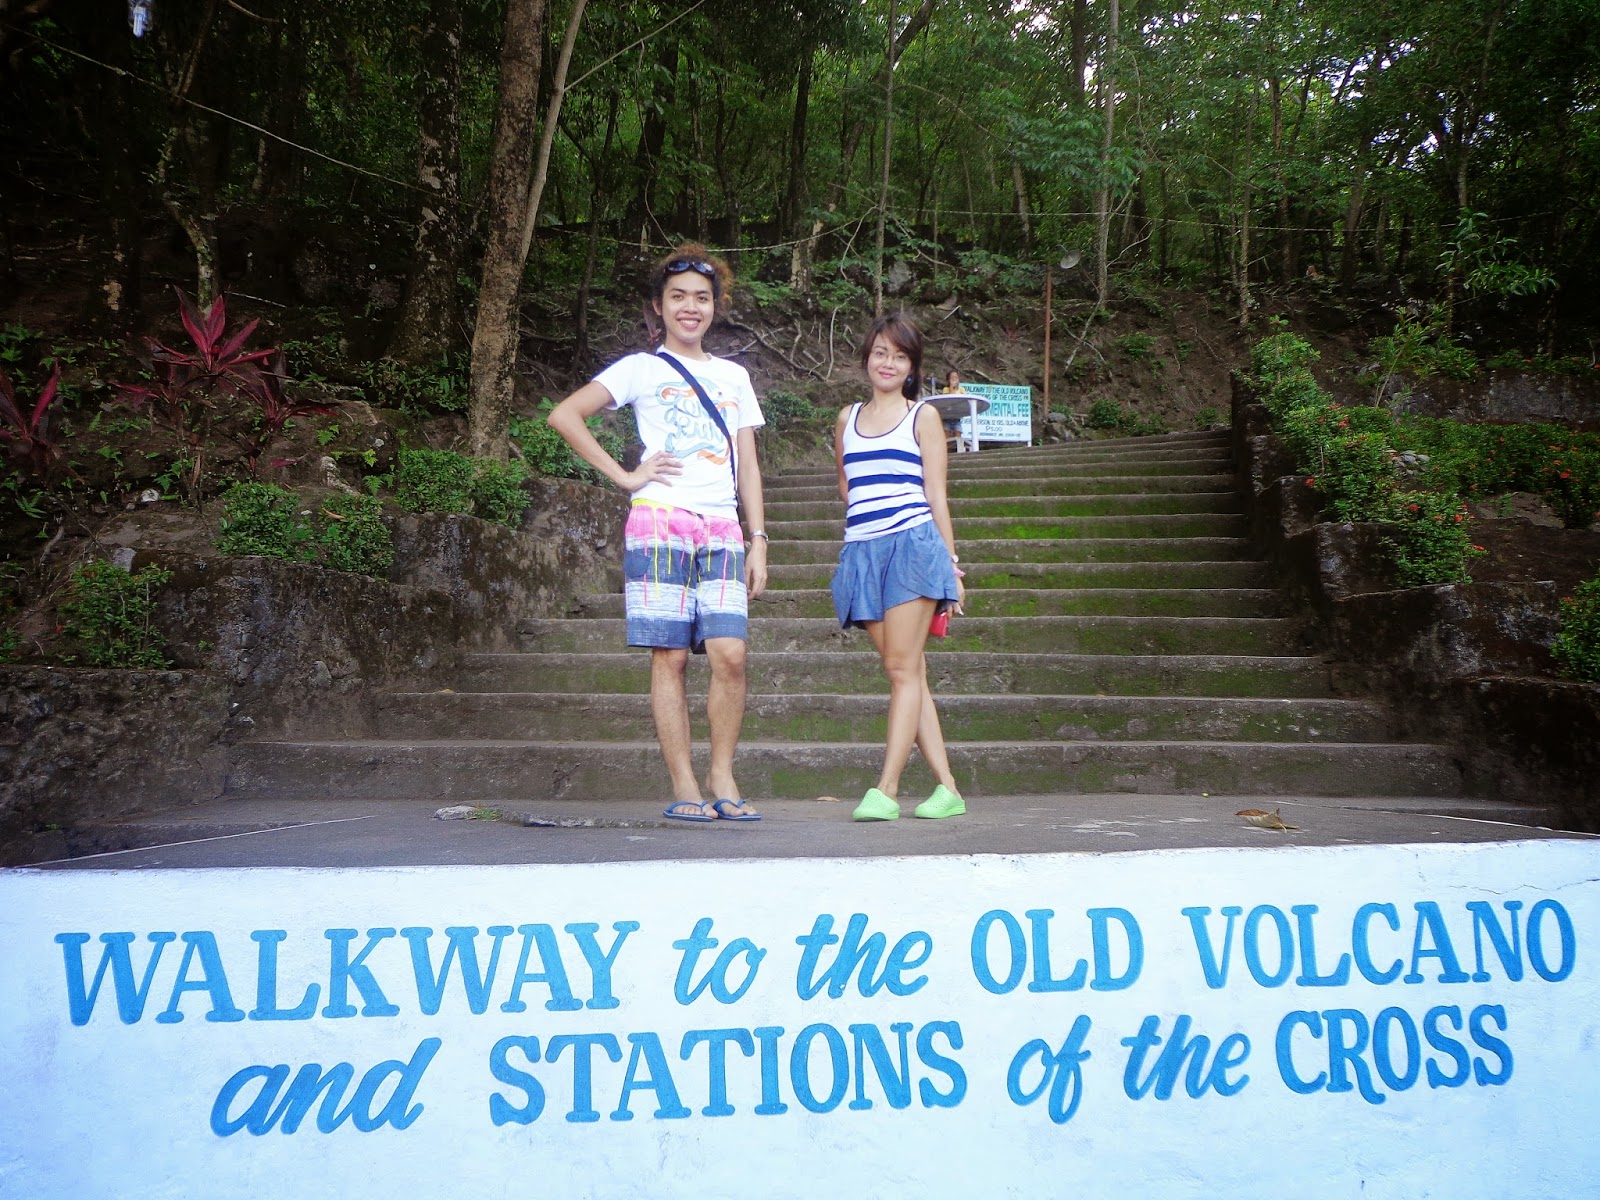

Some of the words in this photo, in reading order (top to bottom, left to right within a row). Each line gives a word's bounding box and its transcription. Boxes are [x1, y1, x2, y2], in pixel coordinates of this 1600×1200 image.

[992, 387, 1000, 395] THE
[1001, 387, 1009, 395] OLD
[1018, 403, 1029, 418] FEE
[54, 921, 640, 1028] WALKWAY
[674, 917, 767, 1006] to
[796, 913, 933, 1000] the
[971, 907, 1144, 995] OLD
[1181, 899, 1577, 990] VOLCANO
[210, 1037, 441, 1138] and
[489, 1021, 968, 1127] STATIONS
[1007, 1014, 1092, 1125] of
[1121, 1014, 1251, 1101] the
[1275, 1003, 1515, 1106] CROSS
